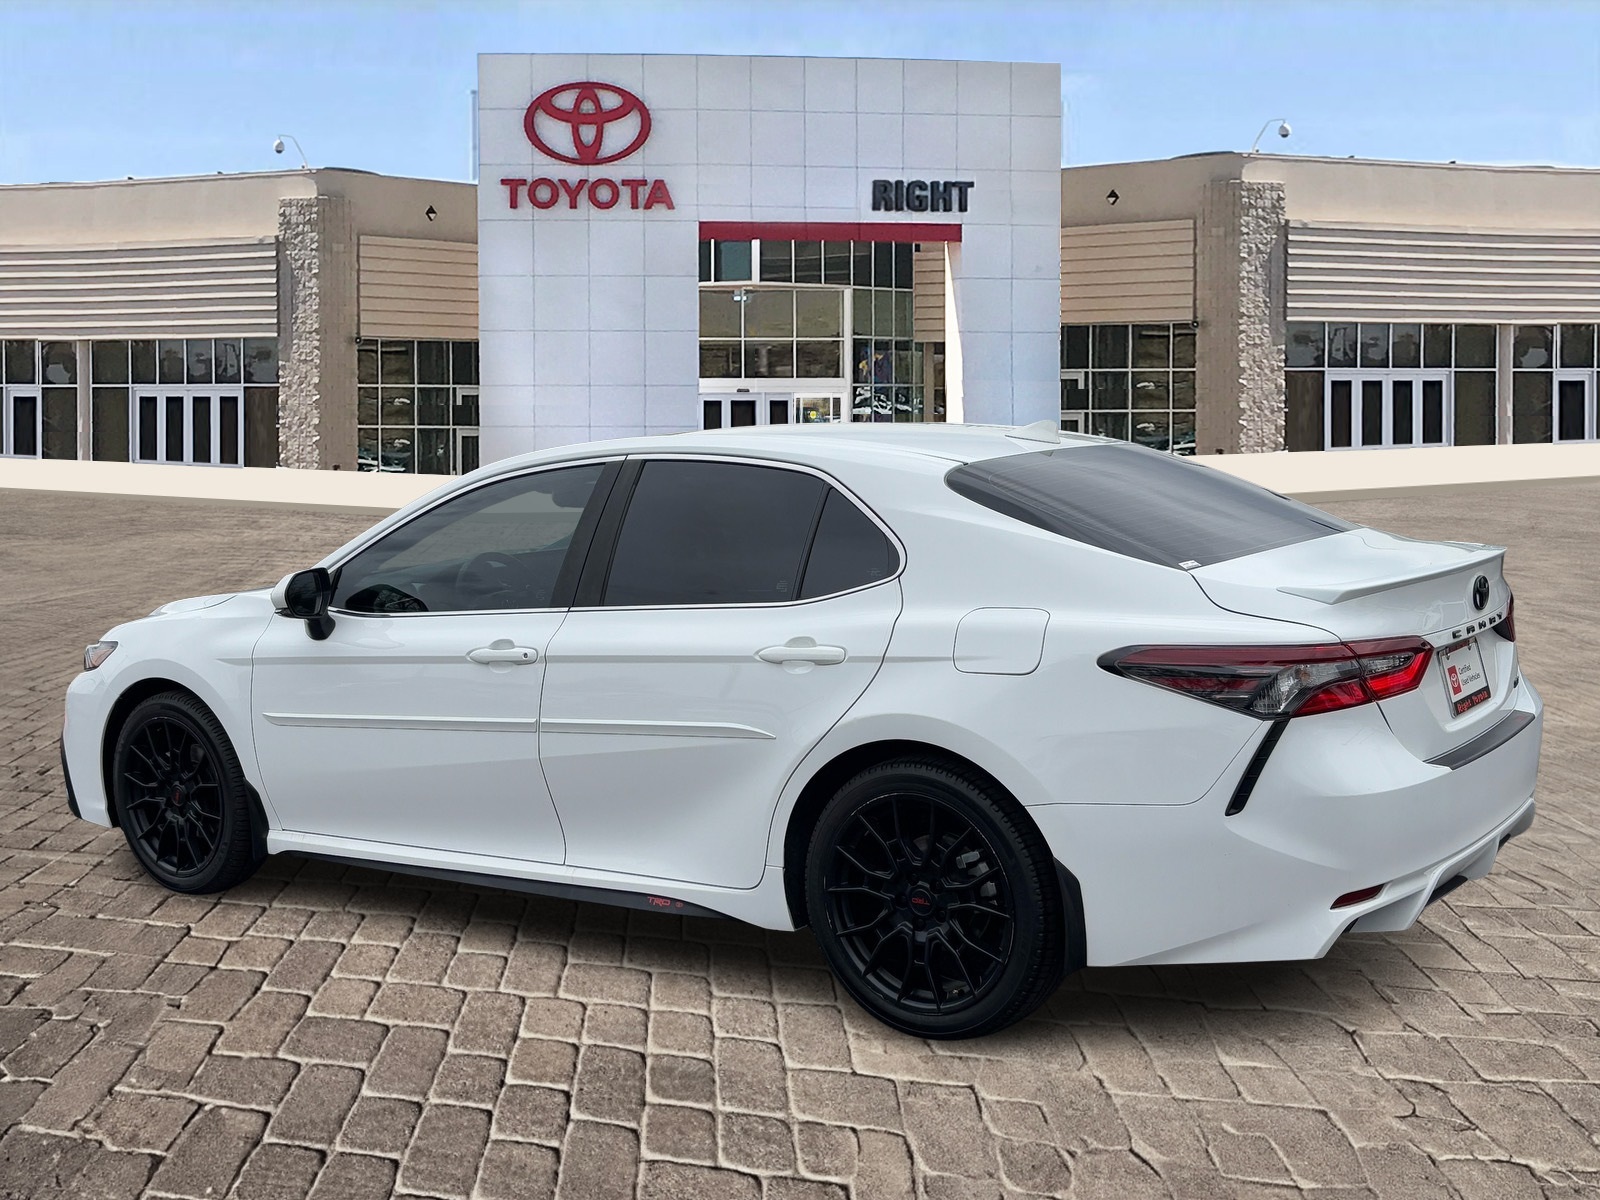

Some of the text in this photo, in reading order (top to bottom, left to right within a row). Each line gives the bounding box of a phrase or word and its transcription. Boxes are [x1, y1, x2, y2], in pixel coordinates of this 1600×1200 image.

[500, 178, 675, 210] TOYOTA
[872, 179, 975, 212] RIGHT
[1452, 611, 1503, 639] CAMRY
[1458, 663, 1471, 675] Certified
[1469, 672, 1481, 684] Vehicles
[1457, 691, 1488, 713] Right Toyota
[647, 896, 671, 906] TRD
